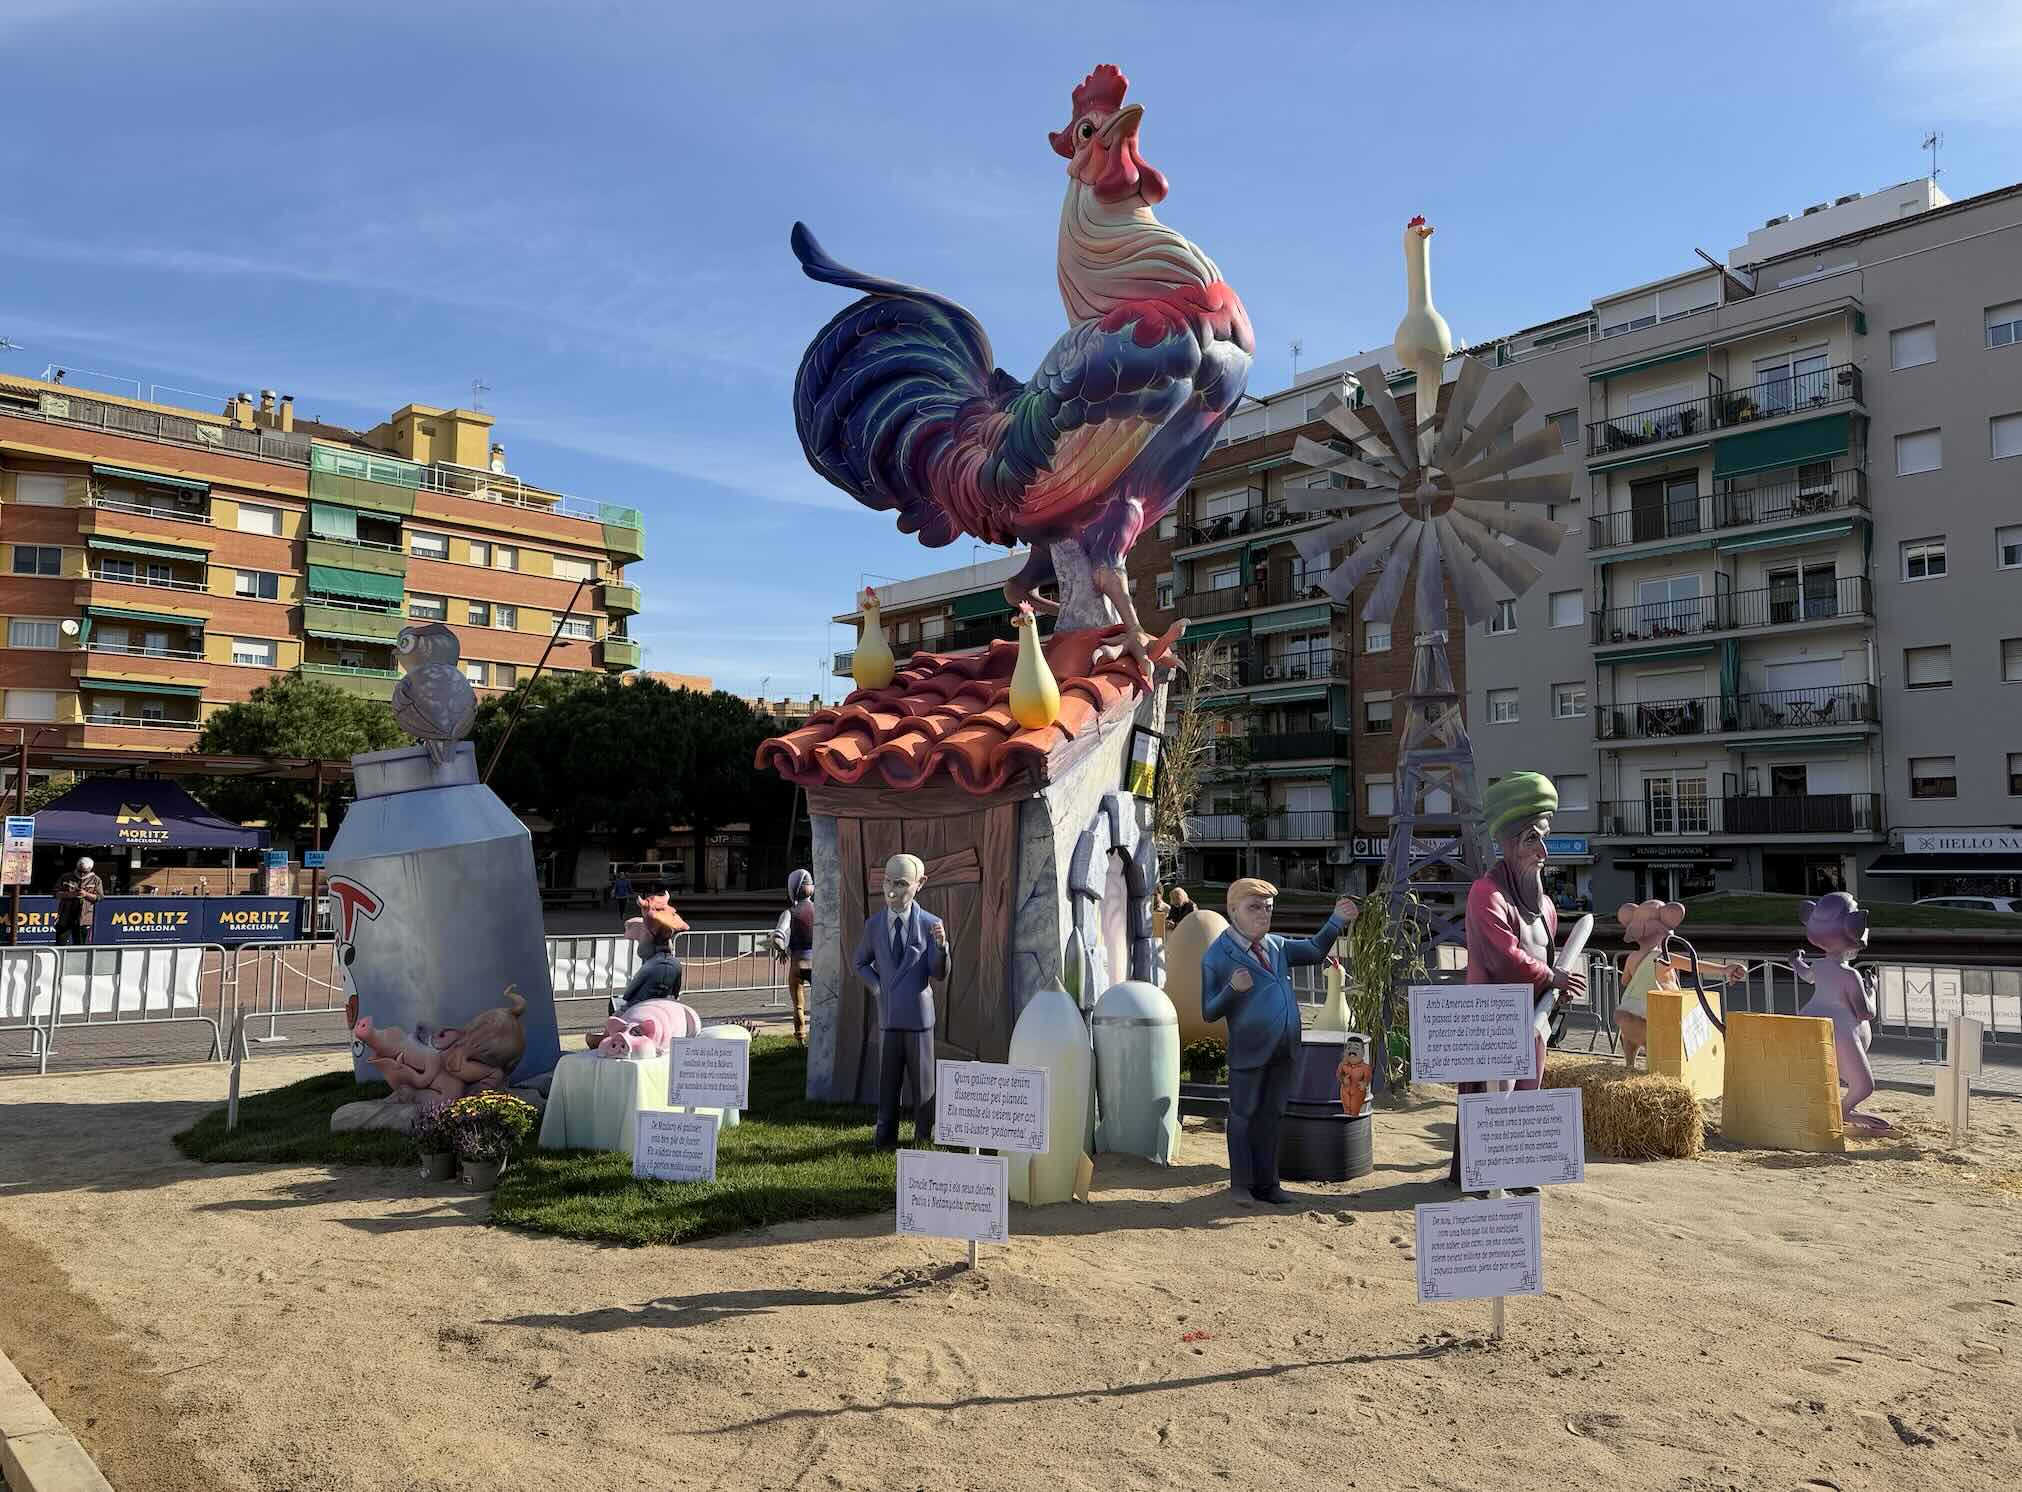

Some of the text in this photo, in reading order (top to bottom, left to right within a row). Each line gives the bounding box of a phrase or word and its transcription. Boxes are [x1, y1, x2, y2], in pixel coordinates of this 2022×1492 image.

[119, 829, 169, 839] MORITZ
[1940, 838, 1993, 849] HELLO
[111, 911, 189, 925] MORITZ
[219, 911, 290, 924] MORITZ
[1426, 999, 1440, 1008] Amb
[998, 1076, 1010, 1089] que
[1013, 1111, 1024, 1124] per
[930, 1179, 949, 1194] Trump
